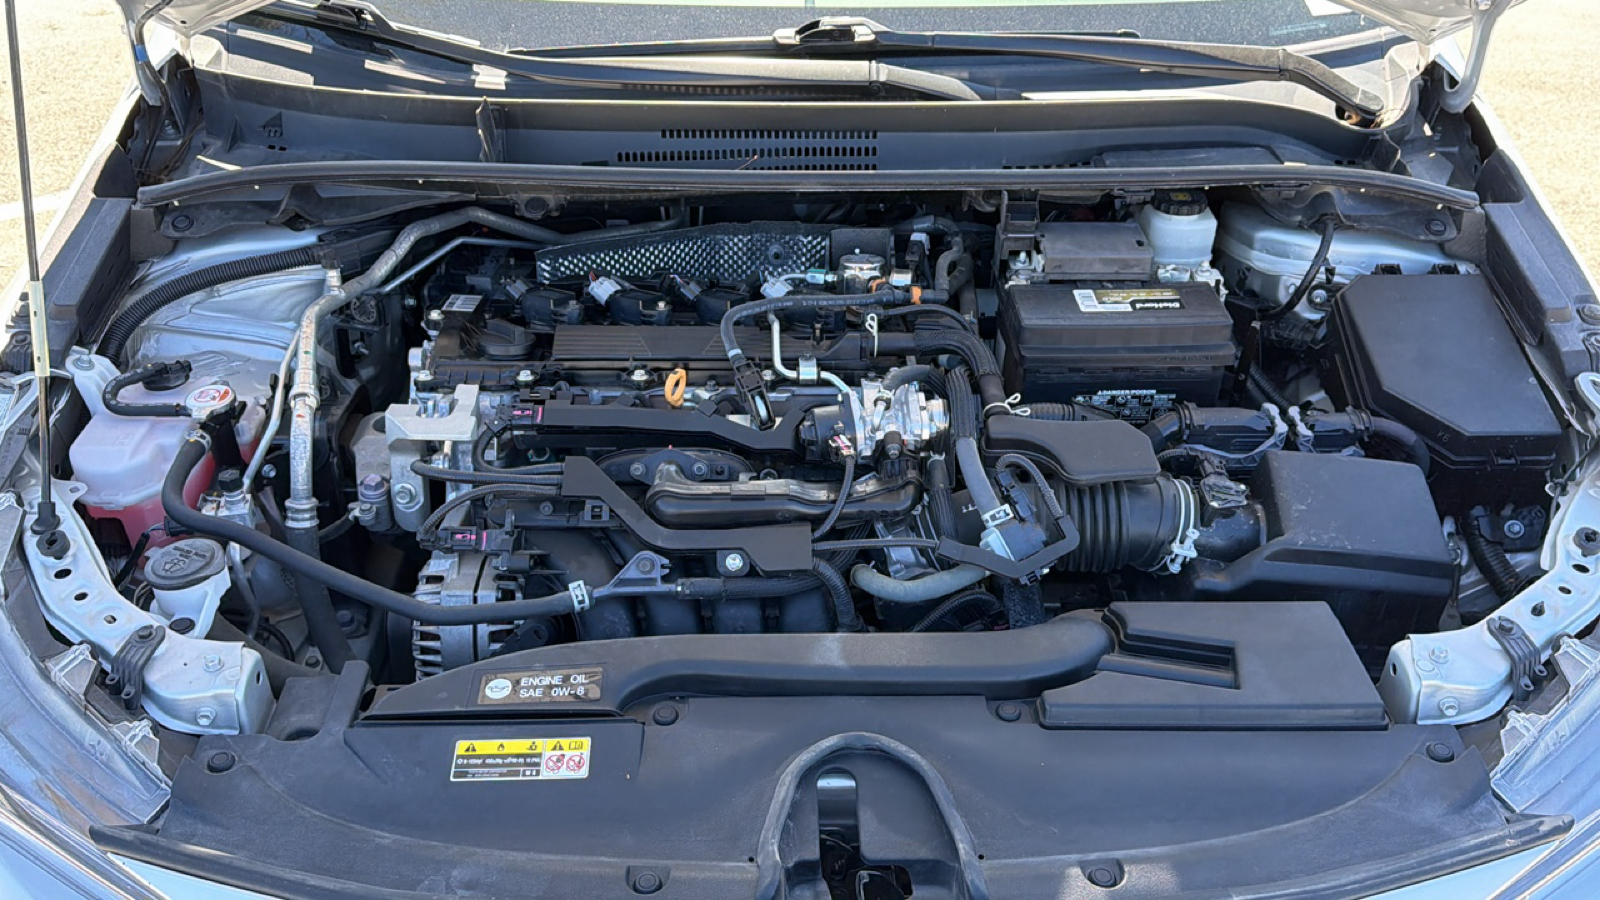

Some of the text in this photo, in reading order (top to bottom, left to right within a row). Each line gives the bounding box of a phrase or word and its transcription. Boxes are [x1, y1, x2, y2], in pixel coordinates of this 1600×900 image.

[1135, 302, 1180, 310] DieHard
[520, 674, 590, 687] ENGINE OIL
[519, 686, 585, 698] SAE 0W-8
